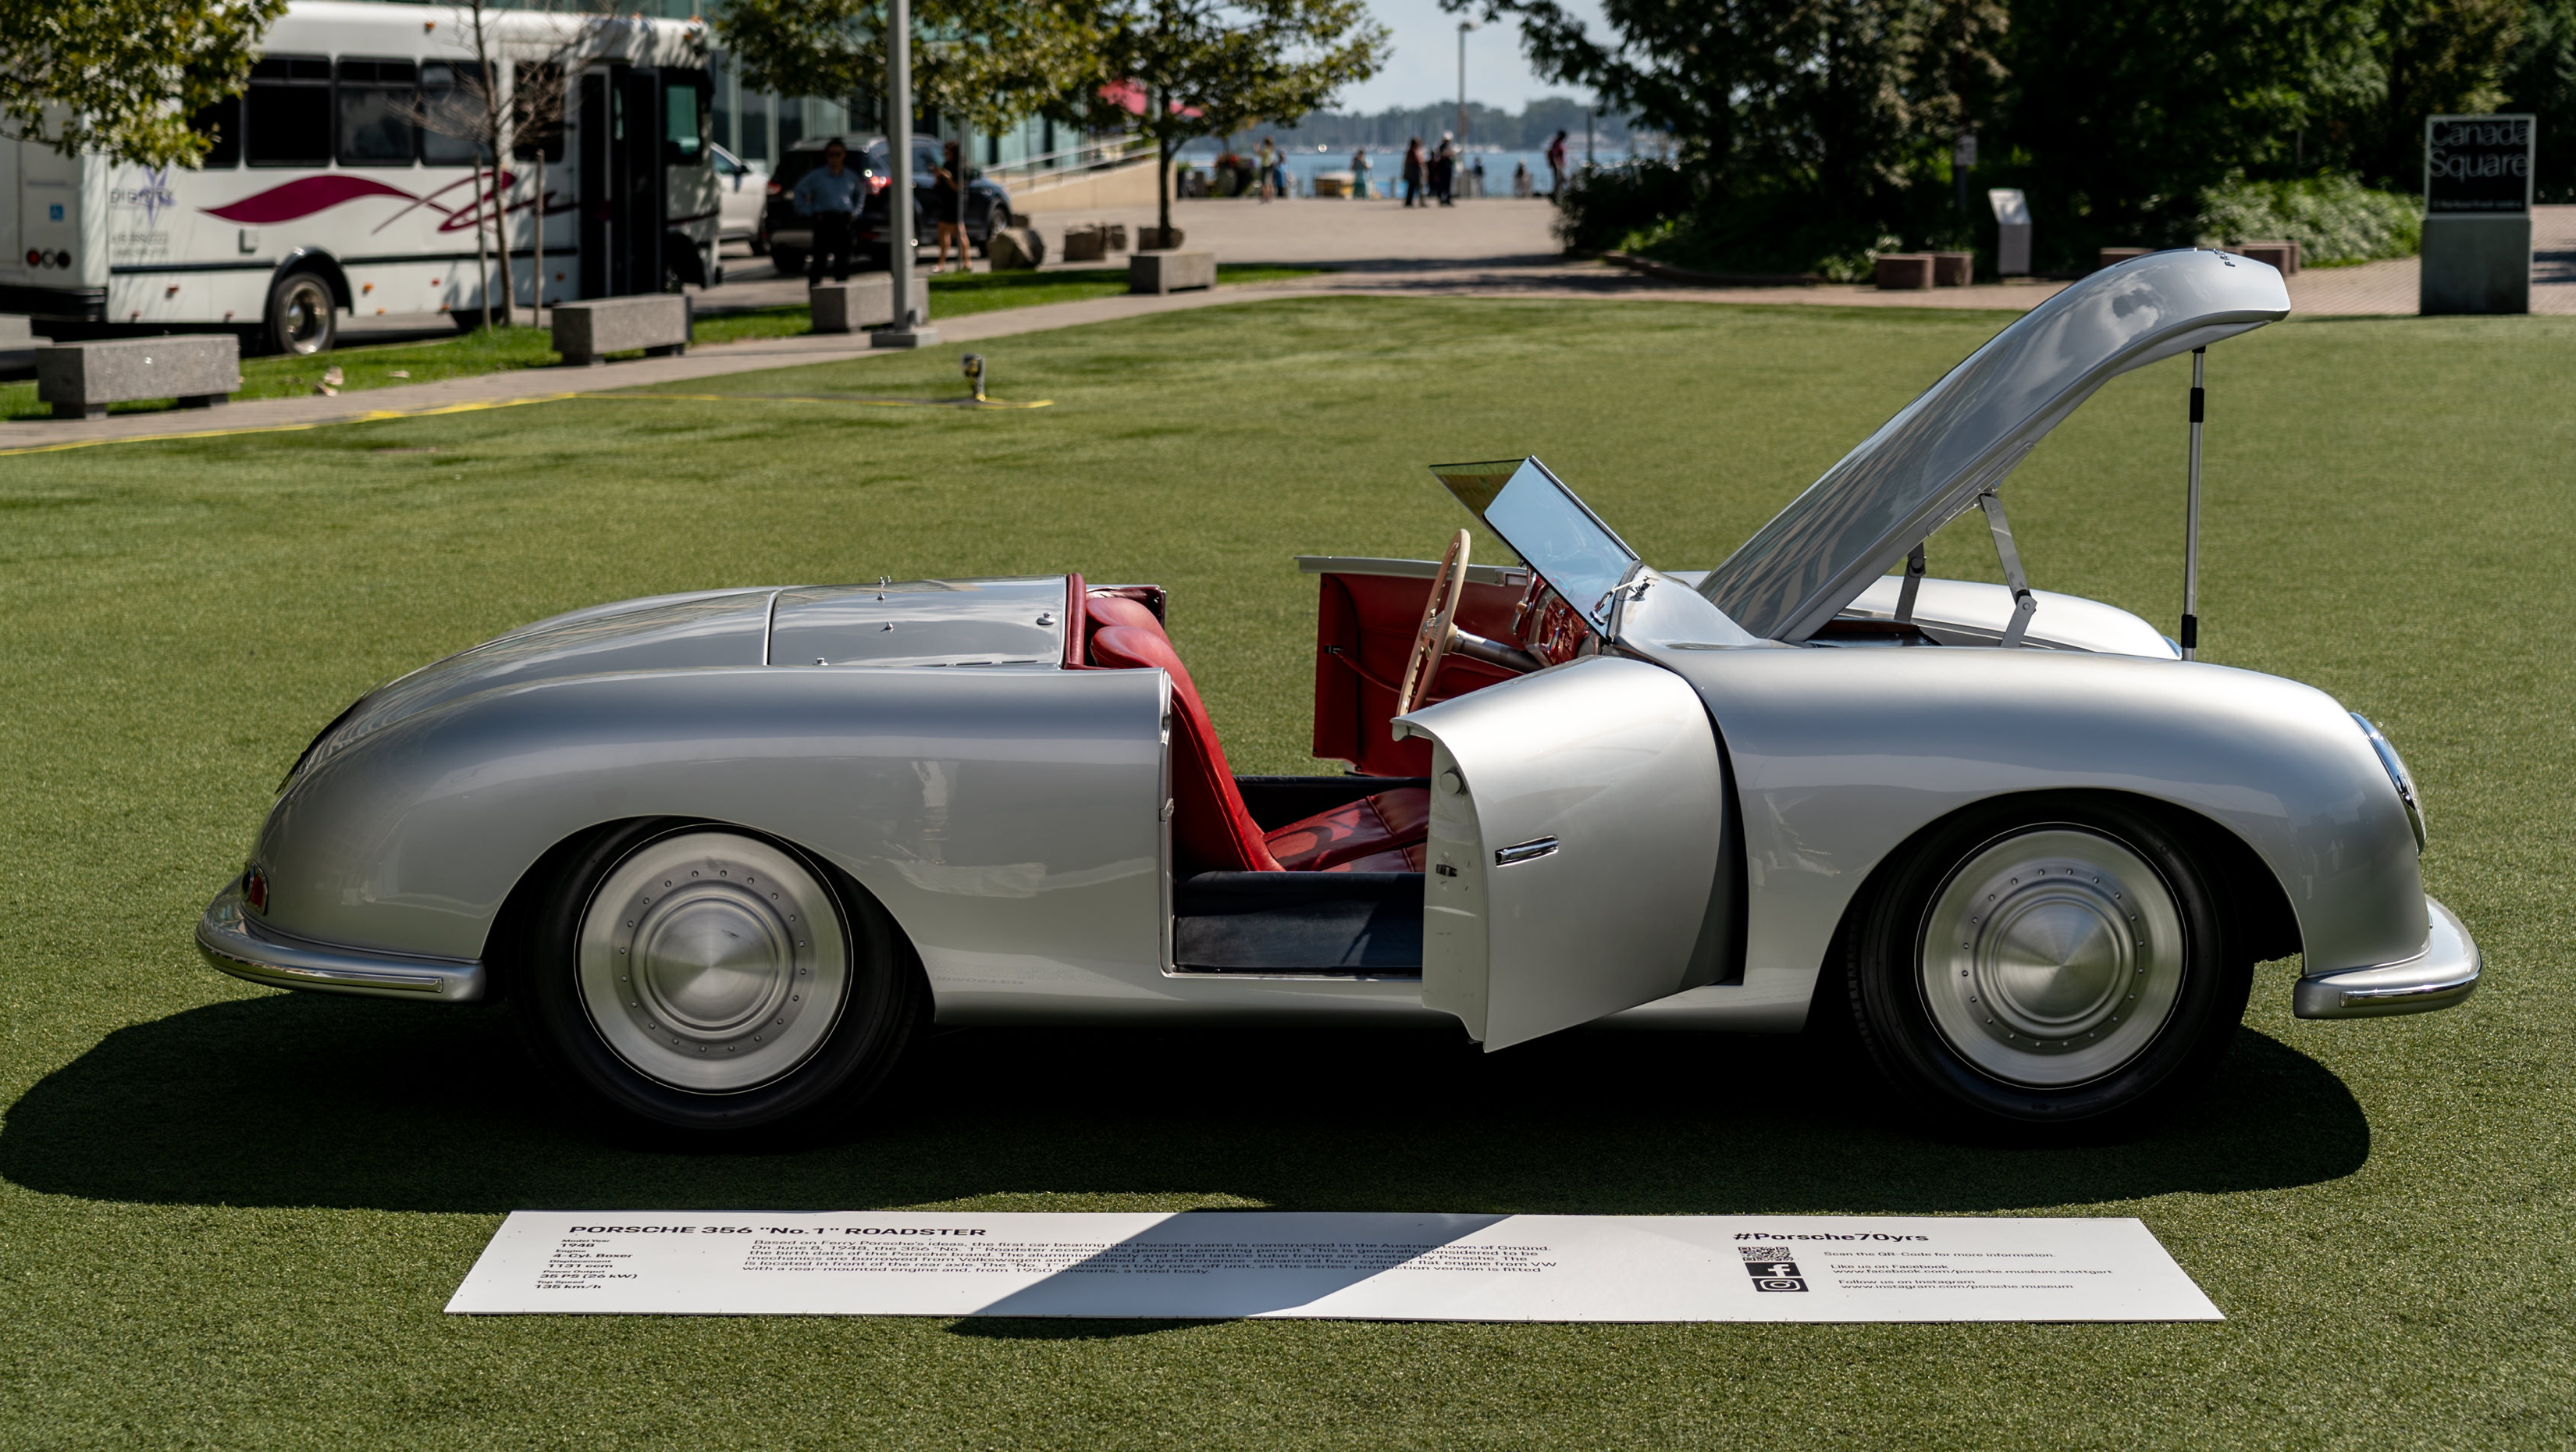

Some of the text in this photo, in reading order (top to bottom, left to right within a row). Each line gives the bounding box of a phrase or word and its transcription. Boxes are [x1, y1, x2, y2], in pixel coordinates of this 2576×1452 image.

[2432, 119, 2529, 146] Canada
[2430, 148, 2529, 183] Square
[1733, 1233, 1929, 1243] #Porsche70yrs
